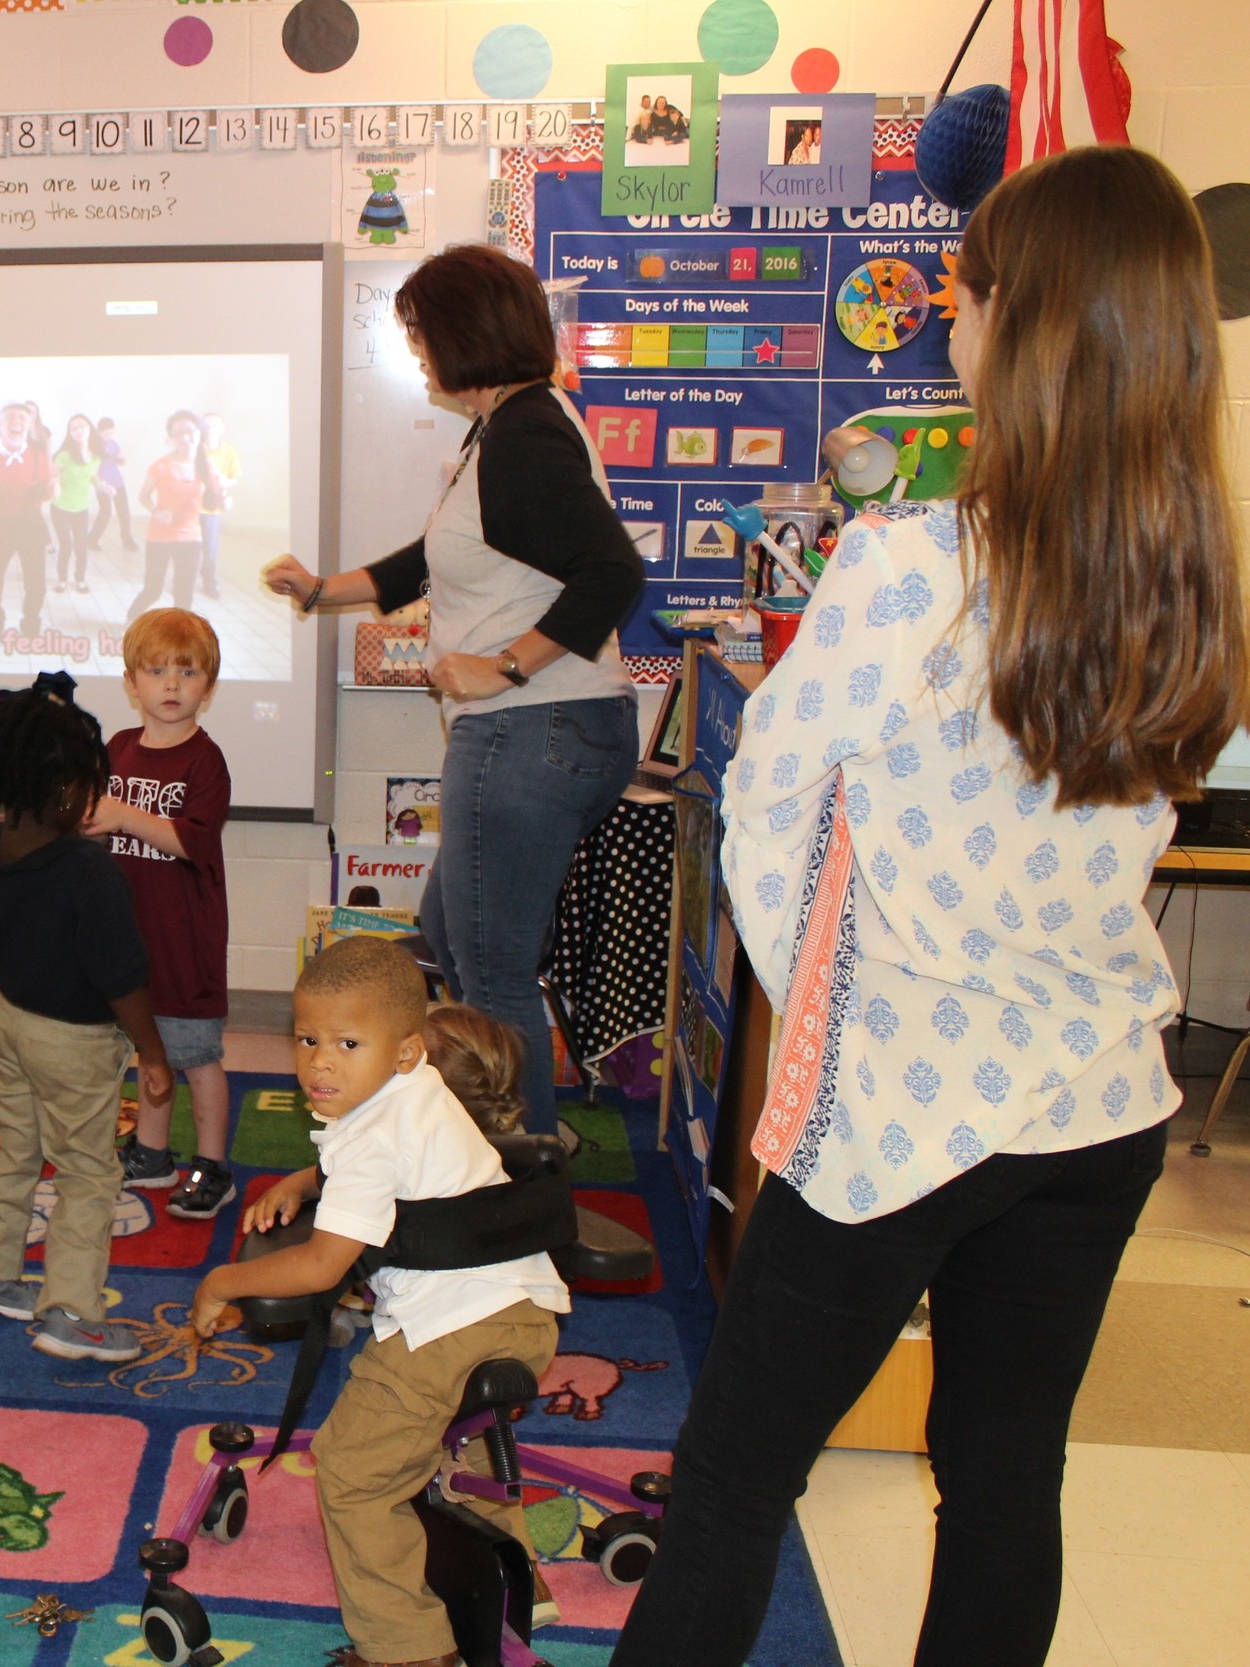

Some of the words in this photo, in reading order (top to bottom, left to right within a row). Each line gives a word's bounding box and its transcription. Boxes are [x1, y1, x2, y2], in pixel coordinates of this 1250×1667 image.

[18, 121, 36, 148] 8
[58, 120, 76, 147] 9
[95, 120, 120, 148] 10
[143, 119, 153, 147] 11
[179, 117, 202, 144] 12
[226, 115, 247, 141] 13
[268, 116, 290, 142] 14
[316, 113, 336, 139] 15
[360, 114, 381, 142] 16
[406, 113, 428, 139] 17
[453, 112, 474, 139] 18
[495, 111, 519, 139] 19
[538, 110, 568, 138] 20
[43, 177, 77, 193] are
[91, 177, 120, 192] we
[760, 166, 845, 197] Kamrell
[616, 176, 691, 213] Skylor
[45, 200, 78, 221] the
[859, 240, 910, 254] What's
[914, 240, 938, 254] the
[942, 240, 964, 254] We
[562, 256, 604, 272] Today
[607, 256, 618, 270] is
[670, 259, 720, 272] October
[733, 258, 752, 273] 21,
[766, 257, 798, 270] 2016
[625, 299, 661, 315] Days
[663, 299, 680, 313] of
[682, 299, 707, 313] the
[710, 299, 749, 313] Week
[624, 388, 667, 402] Letter
[669, 387, 687, 402] of
[688, 388, 712, 402] the
[715, 389, 743, 405] Day
[885, 387, 919, 400] Let's
[597, 417, 642, 452] Ff
[620, 498, 654, 511] Time
[694, 545, 725, 556] triangle
[667, 594, 706, 606] Letters
[708, 594, 718, 606] &
[4, 631, 90, 662] feeling
[347, 855, 426, 879] Farmer
